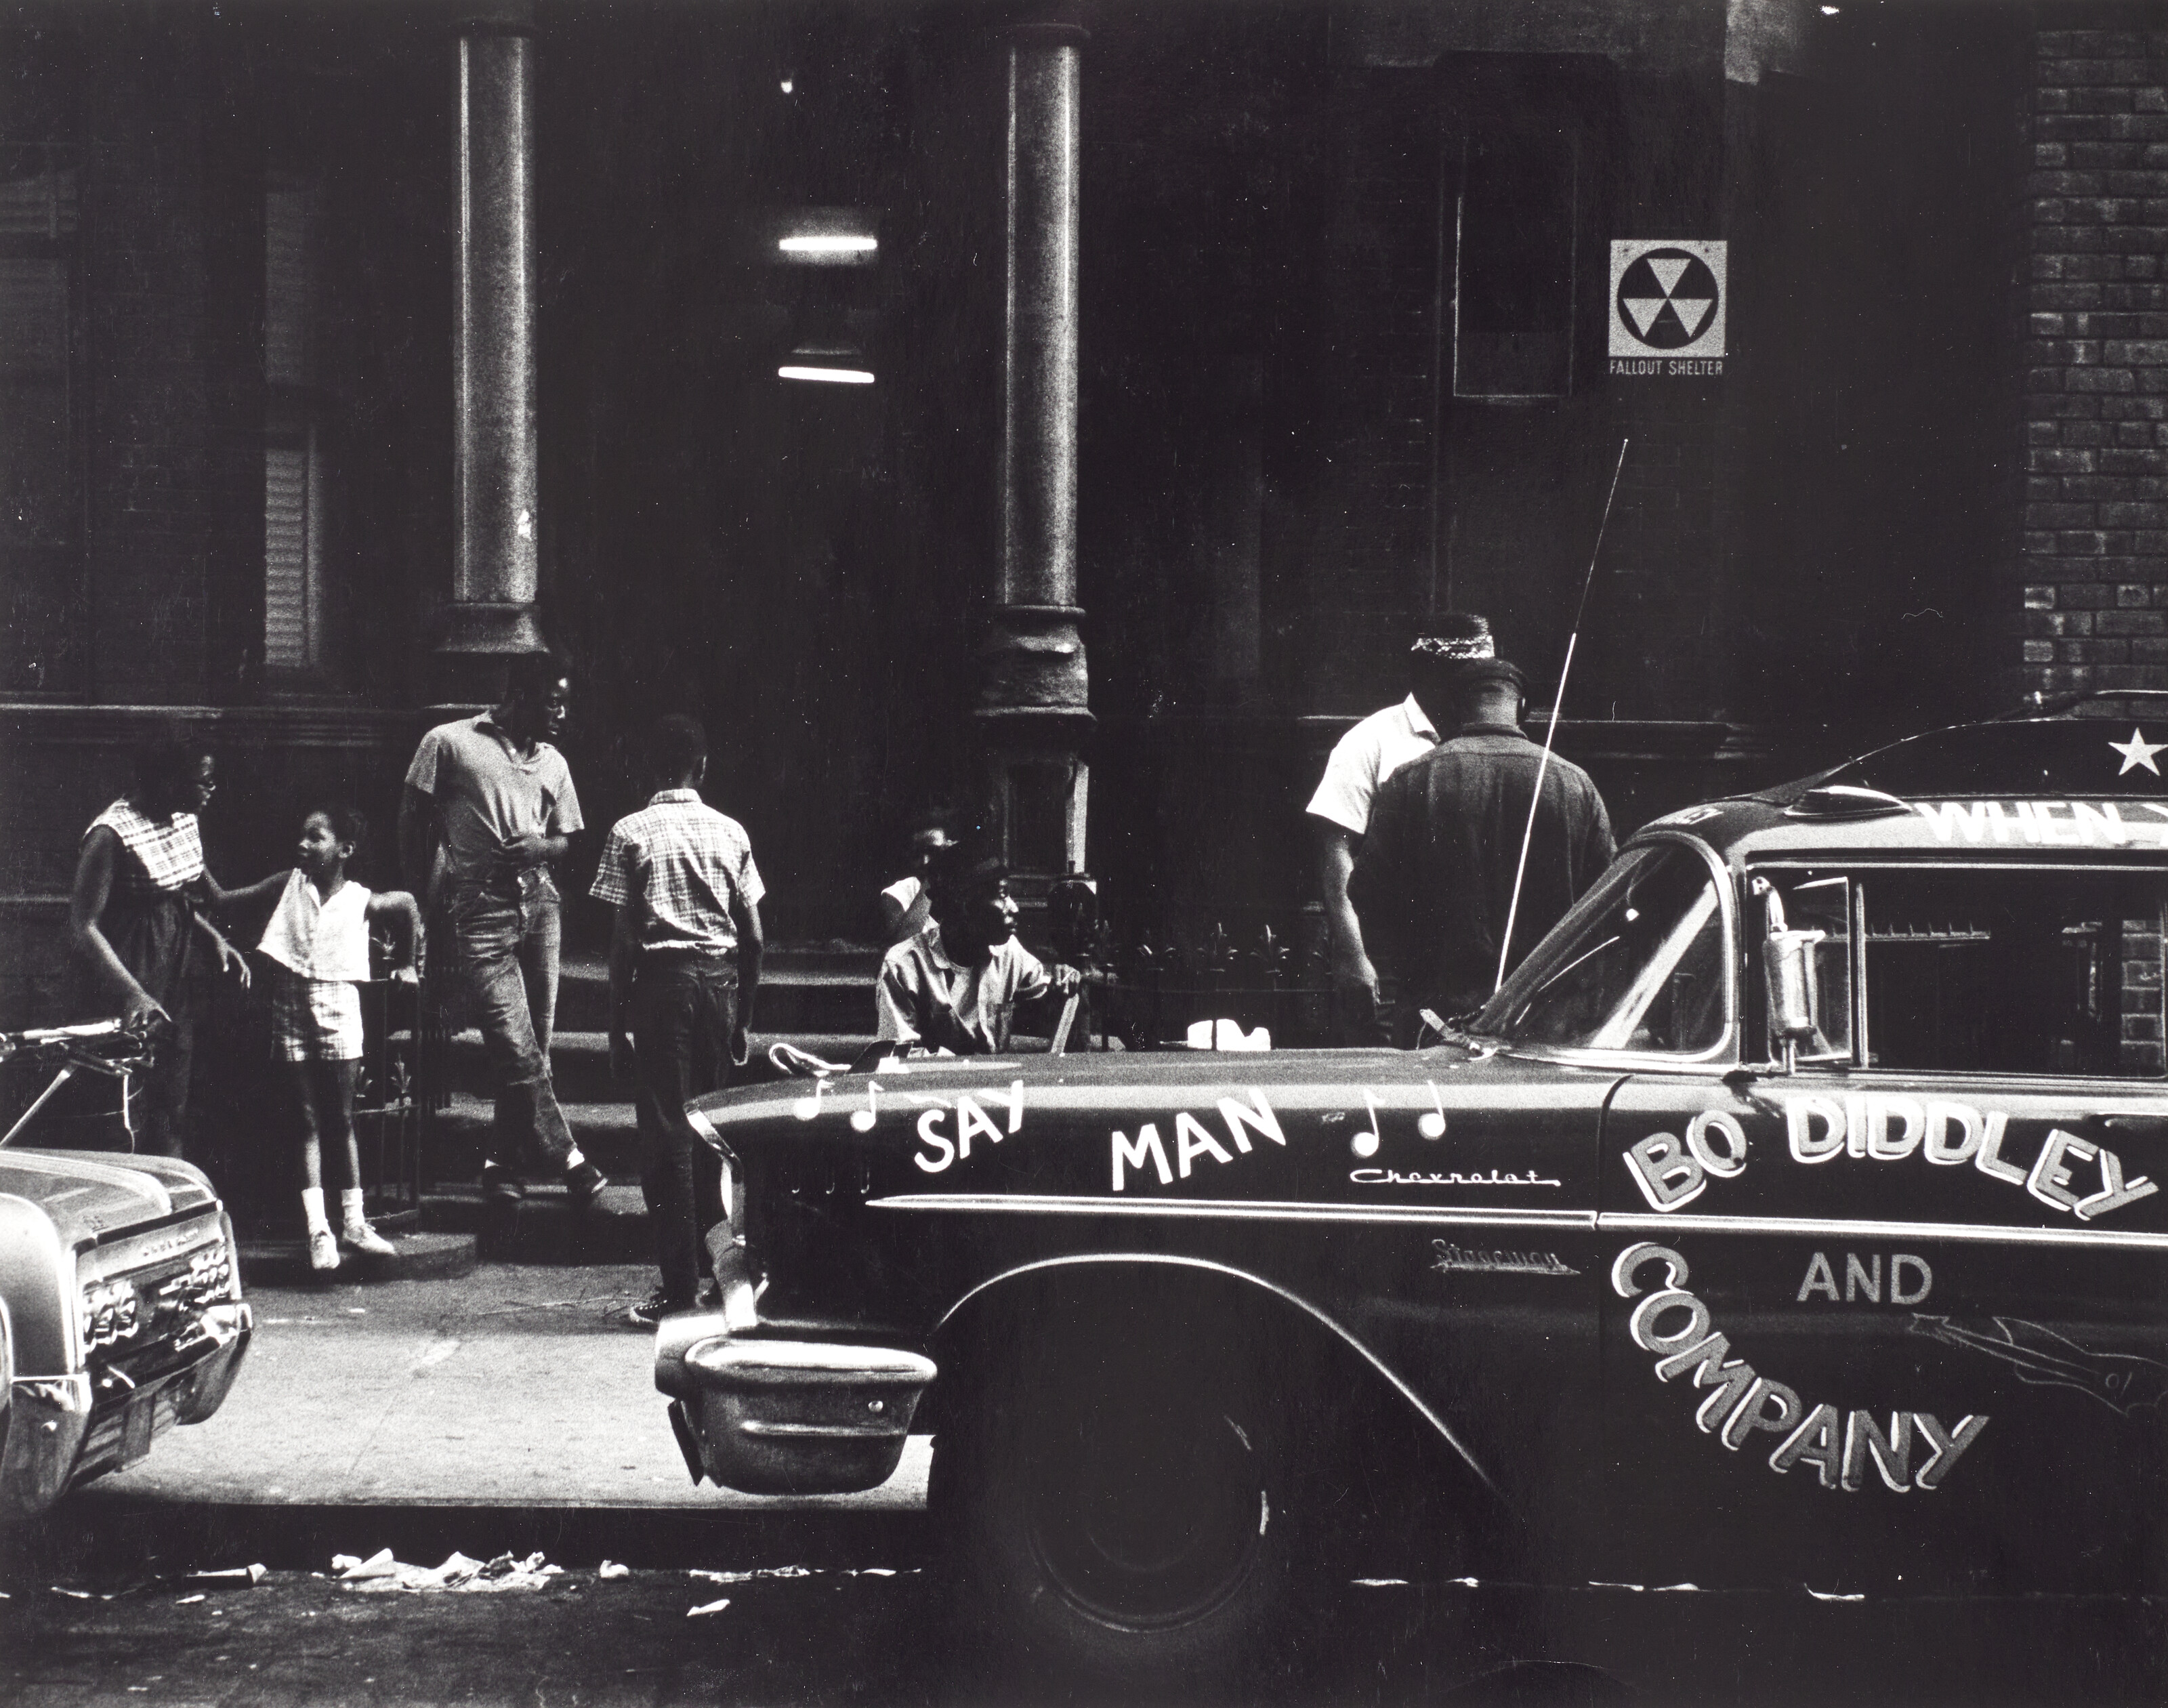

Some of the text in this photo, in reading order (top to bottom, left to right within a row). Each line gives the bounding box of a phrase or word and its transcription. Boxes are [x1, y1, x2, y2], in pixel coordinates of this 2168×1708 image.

[1609, 360, 1723, 375] FALLOUT SHELTER
[1915, 801, 2126, 843] WHEN
[915, 1080, 1286, 1191] SAY MAN
[1623, 1096, 2159, 1221] BO DIDDLEY
[1350, 1169, 1561, 1186] Chevrolet
[1797, 1252, 1932, 1304] AND
[1612, 1242, 1989, 1493] COMPANY
